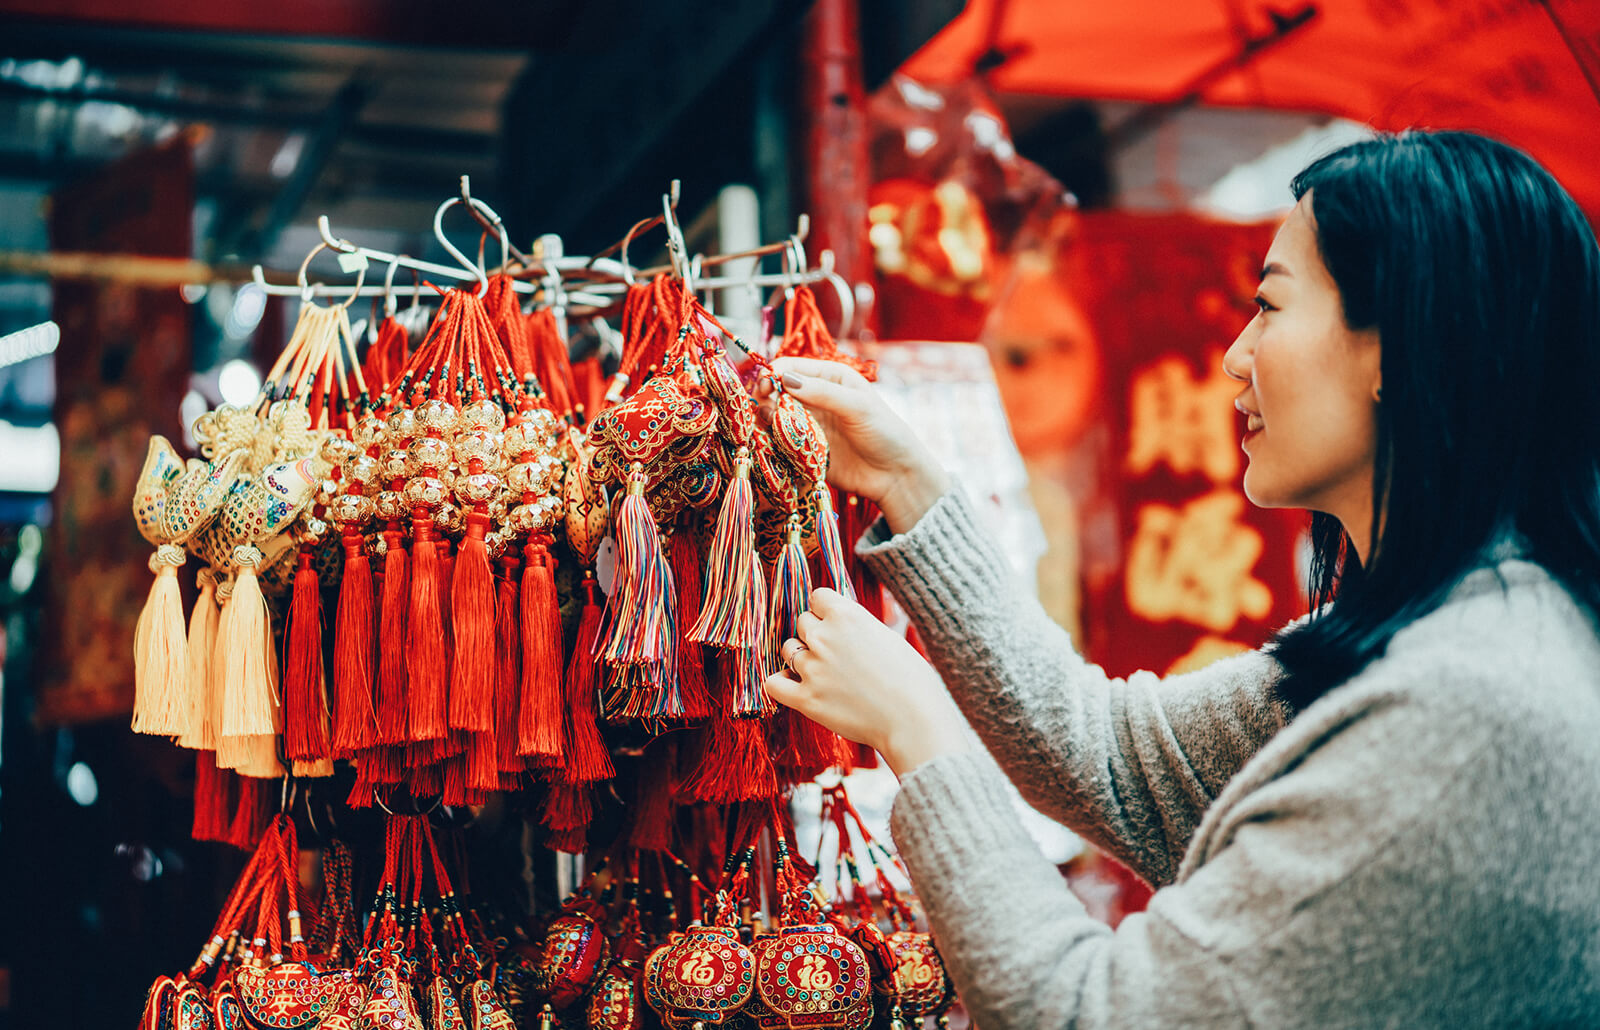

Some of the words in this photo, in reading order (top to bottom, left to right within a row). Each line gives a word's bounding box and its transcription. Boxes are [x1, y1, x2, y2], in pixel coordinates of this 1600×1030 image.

[615, 398, 664, 422] 平安
[681, 950, 715, 986] 福
[797, 955, 833, 990] 福
[901, 951, 932, 987] 福
[269, 963, 304, 1016] 平安
